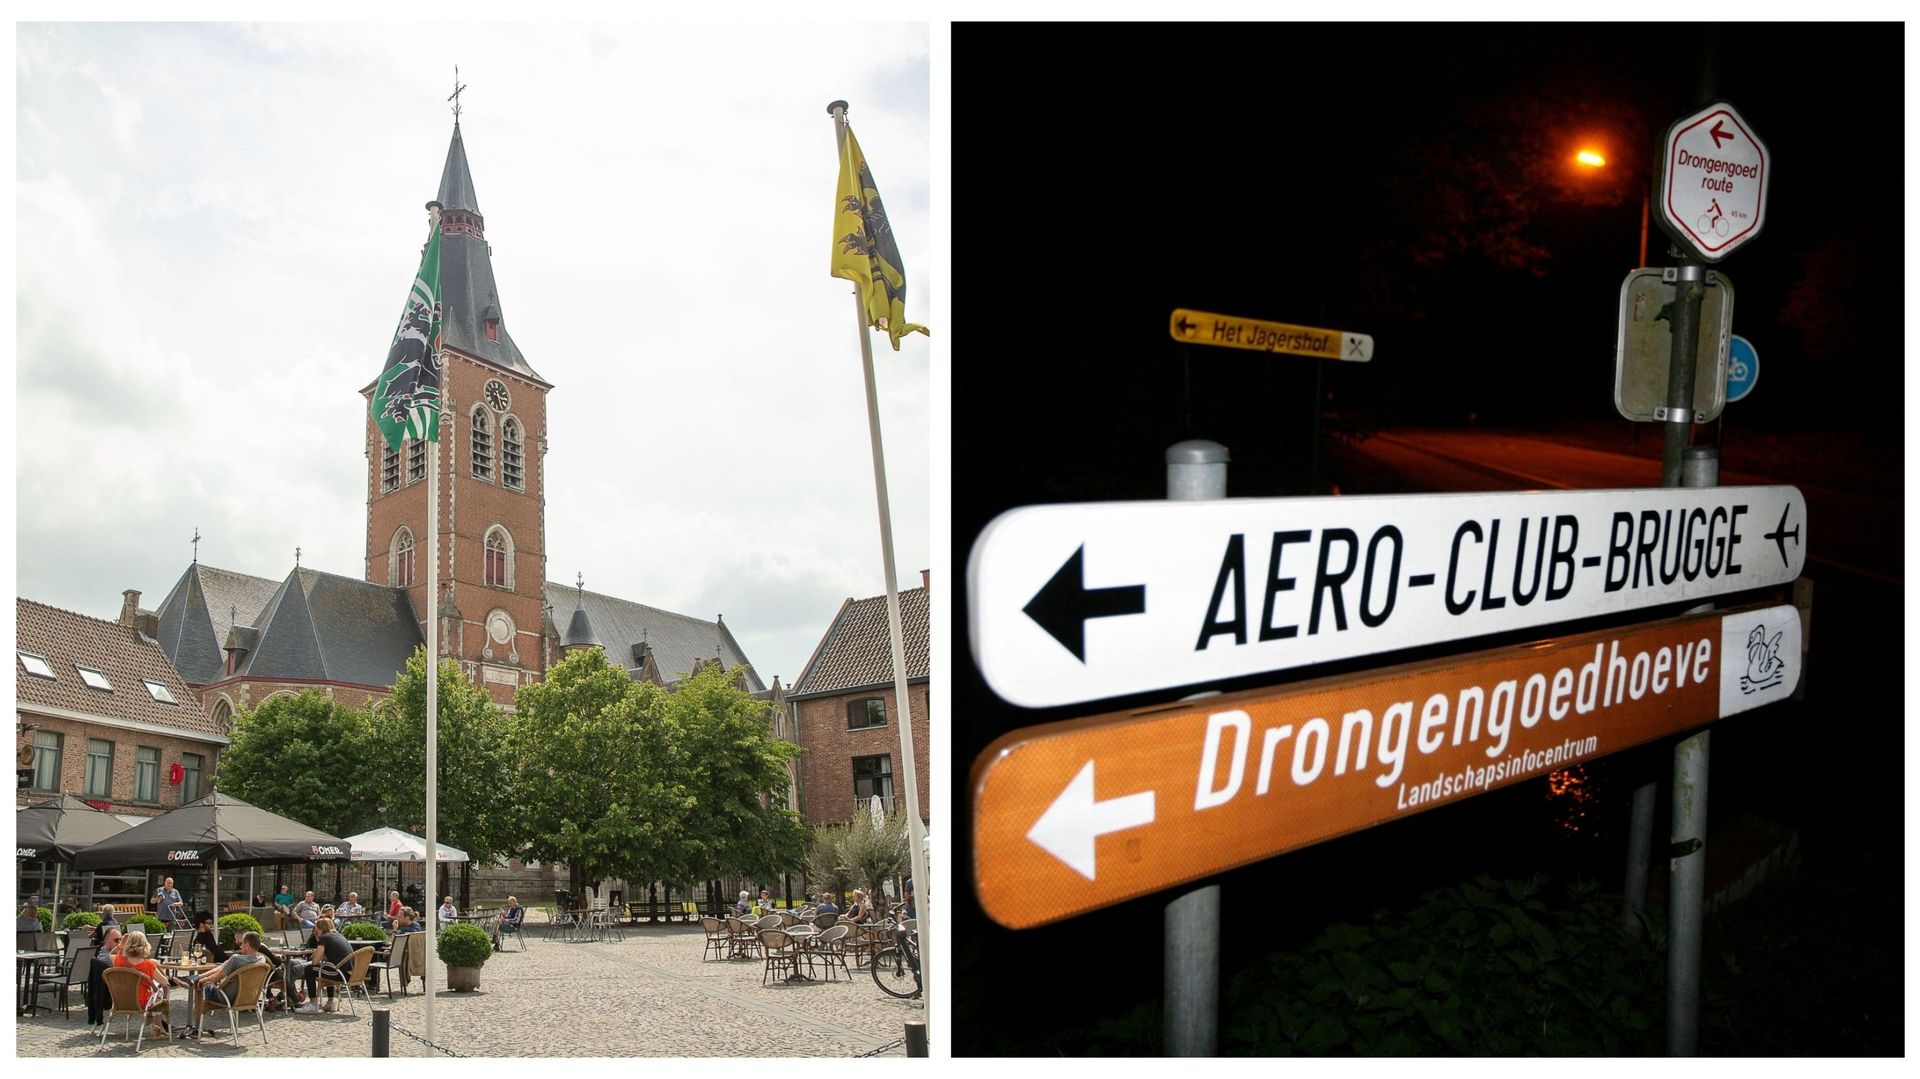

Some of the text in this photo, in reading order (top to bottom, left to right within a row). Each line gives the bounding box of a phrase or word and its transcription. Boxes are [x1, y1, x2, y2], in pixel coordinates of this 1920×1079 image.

[1678, 149, 1758, 179] Drongengoed
[1701, 176, 1733, 193] route
[1739, 211, 1748, 219] km
[1212, 319, 1330, 352] Het Jagershof
[1195, 504, 1748, 651] AERO-CLUB-BRUGGE
[1194, 637, 1712, 811] Drongengoedhoeve
[1397, 735, 1598, 810] Landschapsinfocentrum
